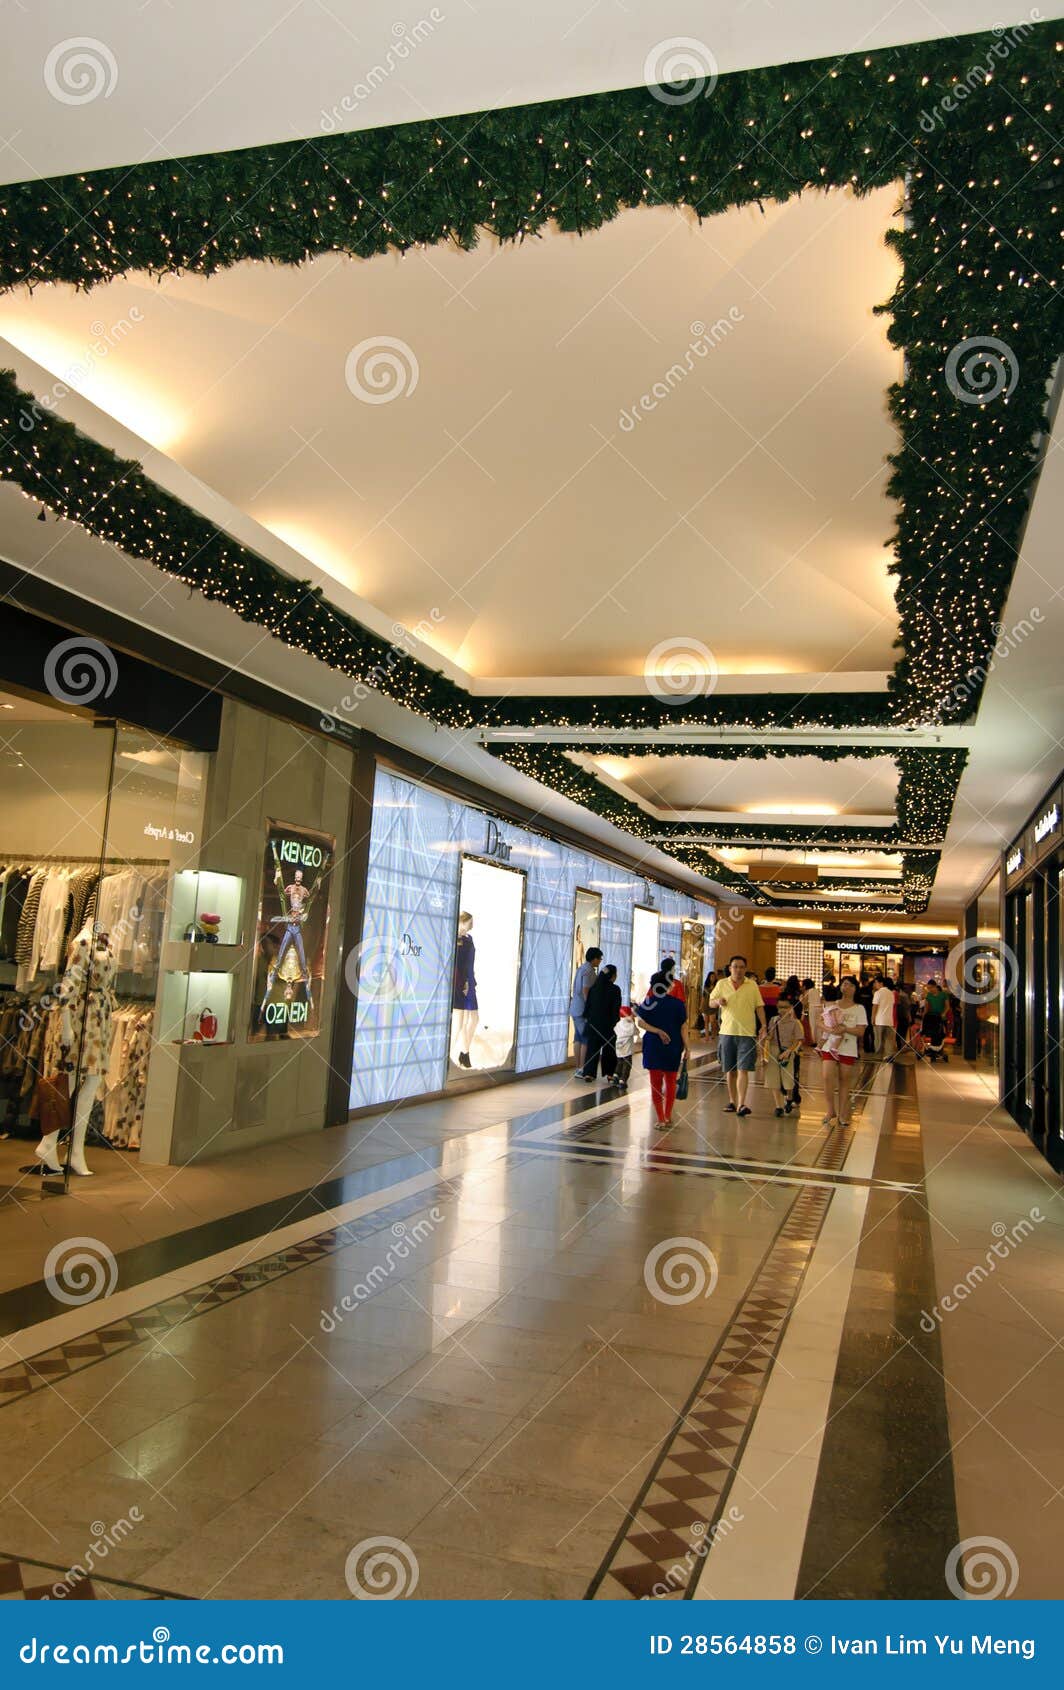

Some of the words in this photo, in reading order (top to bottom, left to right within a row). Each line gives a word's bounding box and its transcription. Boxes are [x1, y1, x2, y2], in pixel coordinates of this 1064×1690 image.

[485, 820, 512, 861] Dior
[280, 839, 322, 868] KENZO
[401, 933, 423, 956] Dior
[836, 942, 858, 950] LOUIS
[859, 943, 891, 952] VUITTON
[265, 1001, 309, 1025] KENZO
